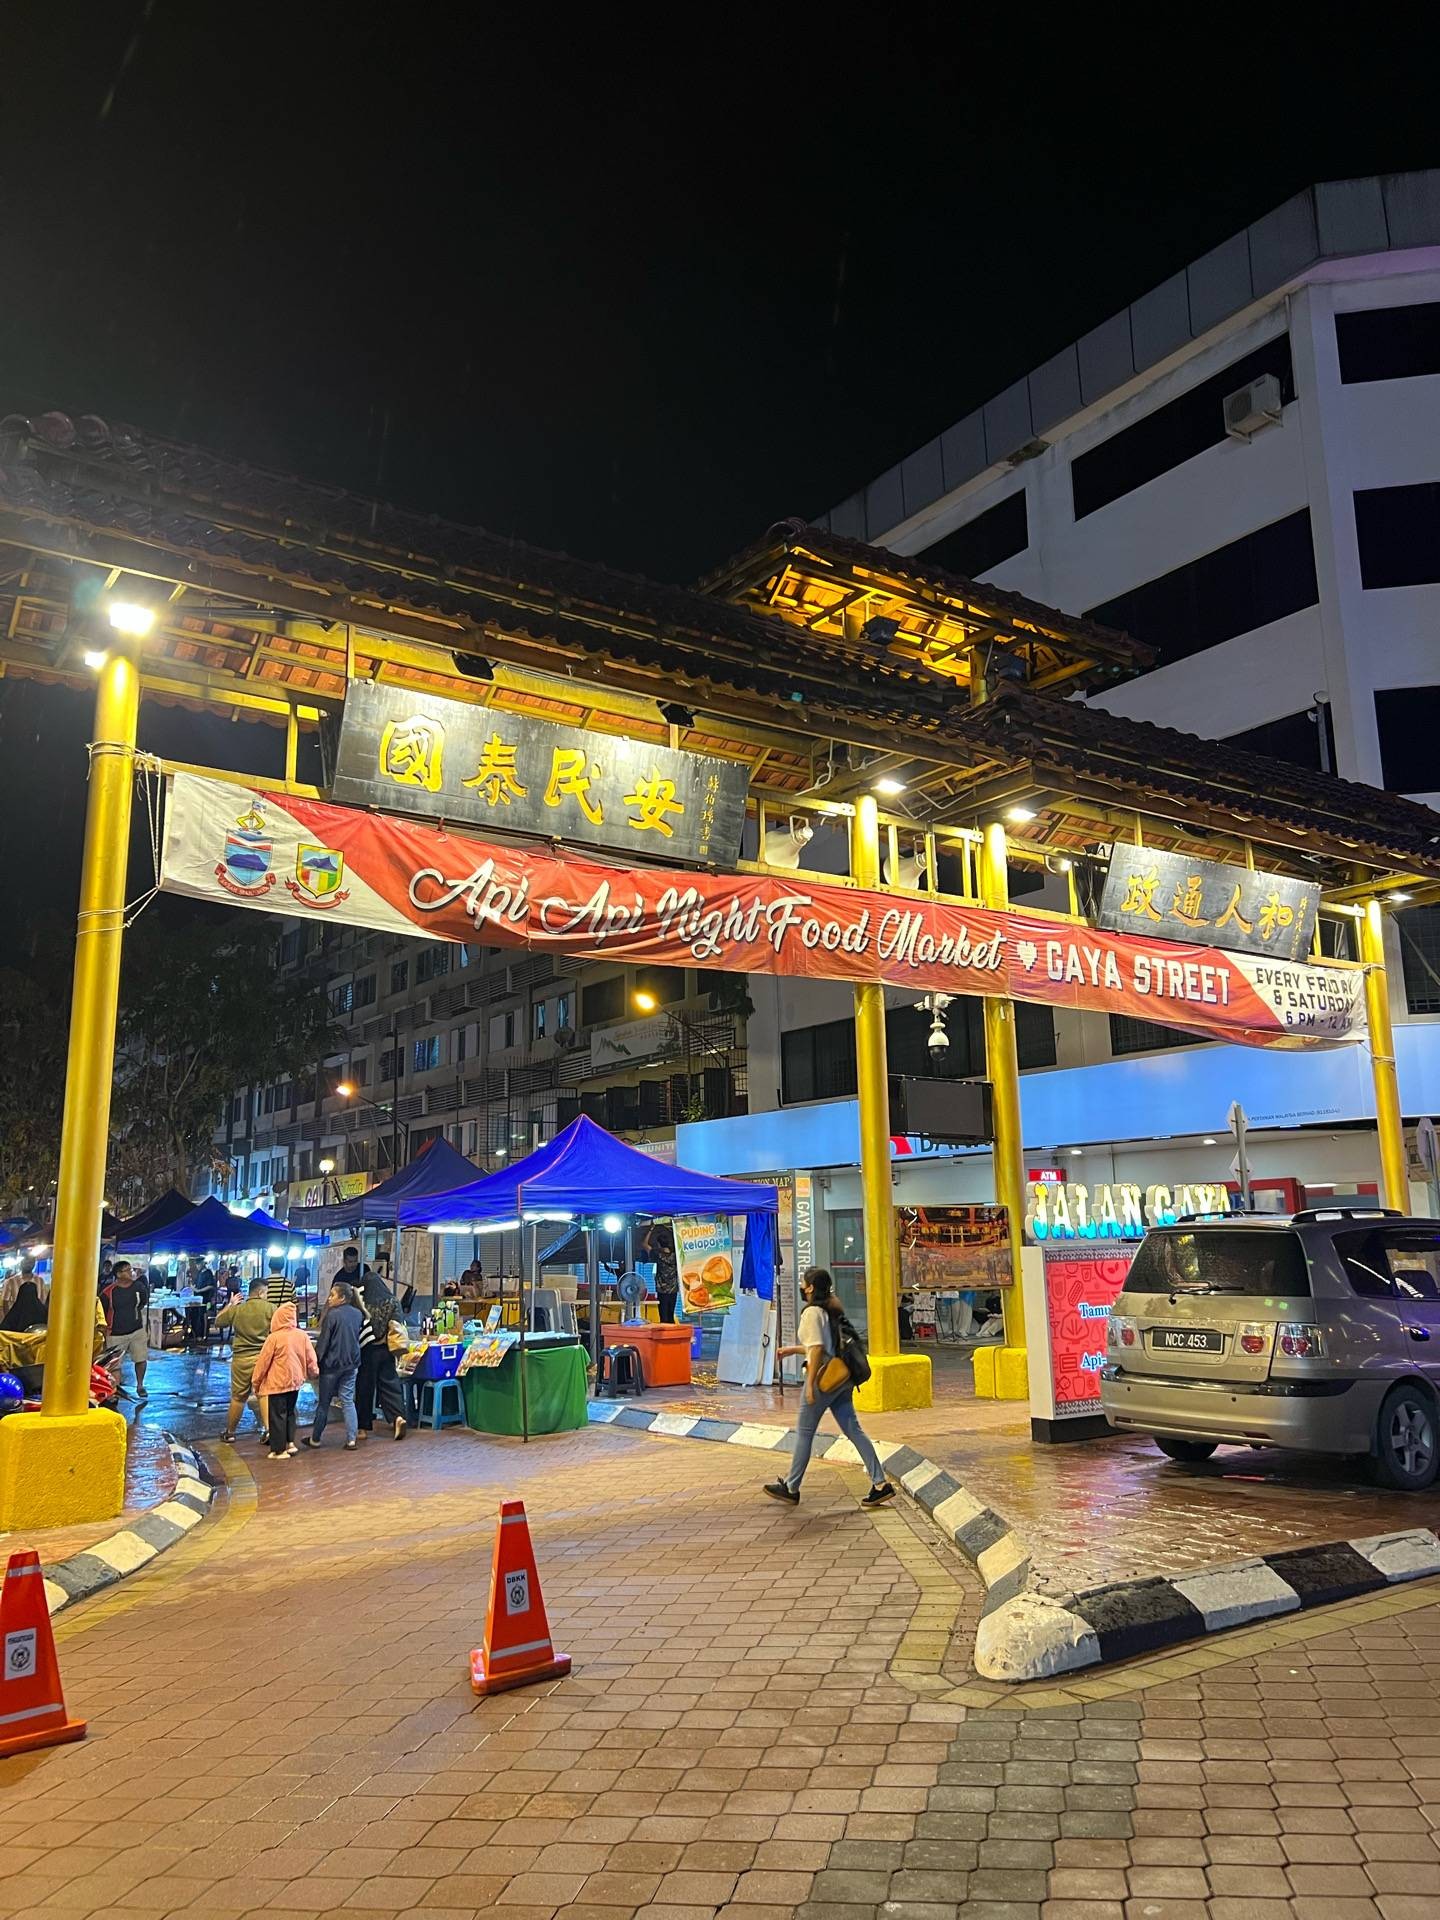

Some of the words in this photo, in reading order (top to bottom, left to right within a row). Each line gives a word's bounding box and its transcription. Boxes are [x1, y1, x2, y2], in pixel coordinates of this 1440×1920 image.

[379, 713, 685, 838] 國泰民安
[1120, 865, 1294, 940] 政通人和
[409, 858, 530, 931] Api
[541, 879, 646, 945] Api
[656, 886, 767, 959] Night
[766, 895, 871, 953] Food
[877, 908, 1008, 971] Market
[1046, 940, 1123, 991] GAYA
[1133, 955, 1231, 1006] STREET
[1255, 967, 1300, 989] EVERY
[1273, 989, 1282, 1006] &
[1286, 1011, 1293, 1025] 6
[1298, 1012, 1316, 1027] PM
[1040, 1171, 1057, 1180] ATM
[796, 1201, 811, 1234] GAYA
[1032, 1183, 1146, 1240] JALAN
[681, 1224, 715, 1239] PUDING
[797, 1240, 811, 1284] STRE
[1165, 1333, 1185, 1347] NCC
